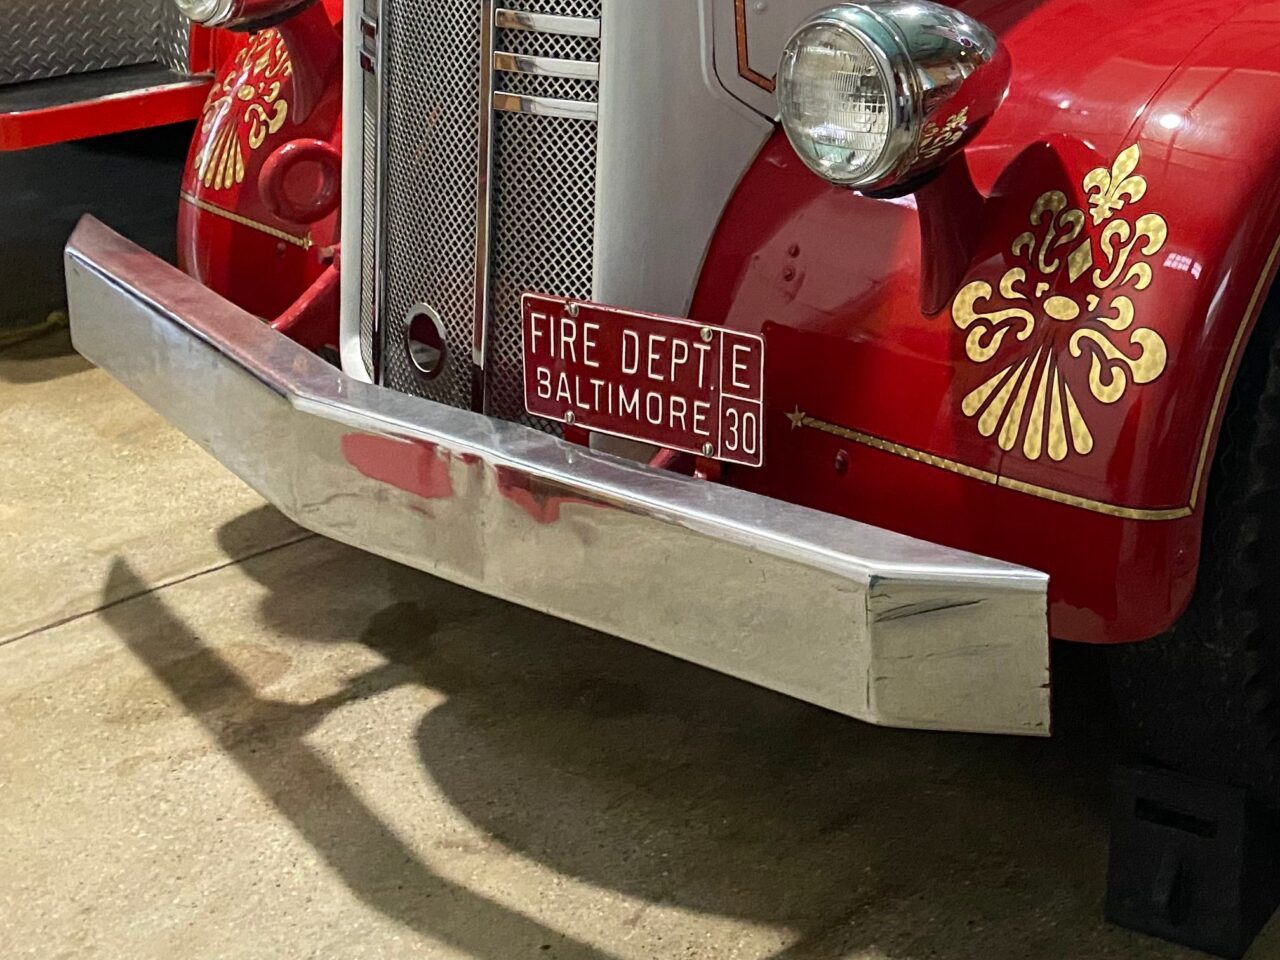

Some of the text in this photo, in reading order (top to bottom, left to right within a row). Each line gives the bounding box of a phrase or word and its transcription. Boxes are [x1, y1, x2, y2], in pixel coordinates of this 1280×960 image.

[530, 312, 715, 391] FIRE DEPT.
[731, 344, 751, 389] E
[536, 366, 711, 436] BALTIMORE
[725, 408, 757, 455] 30
